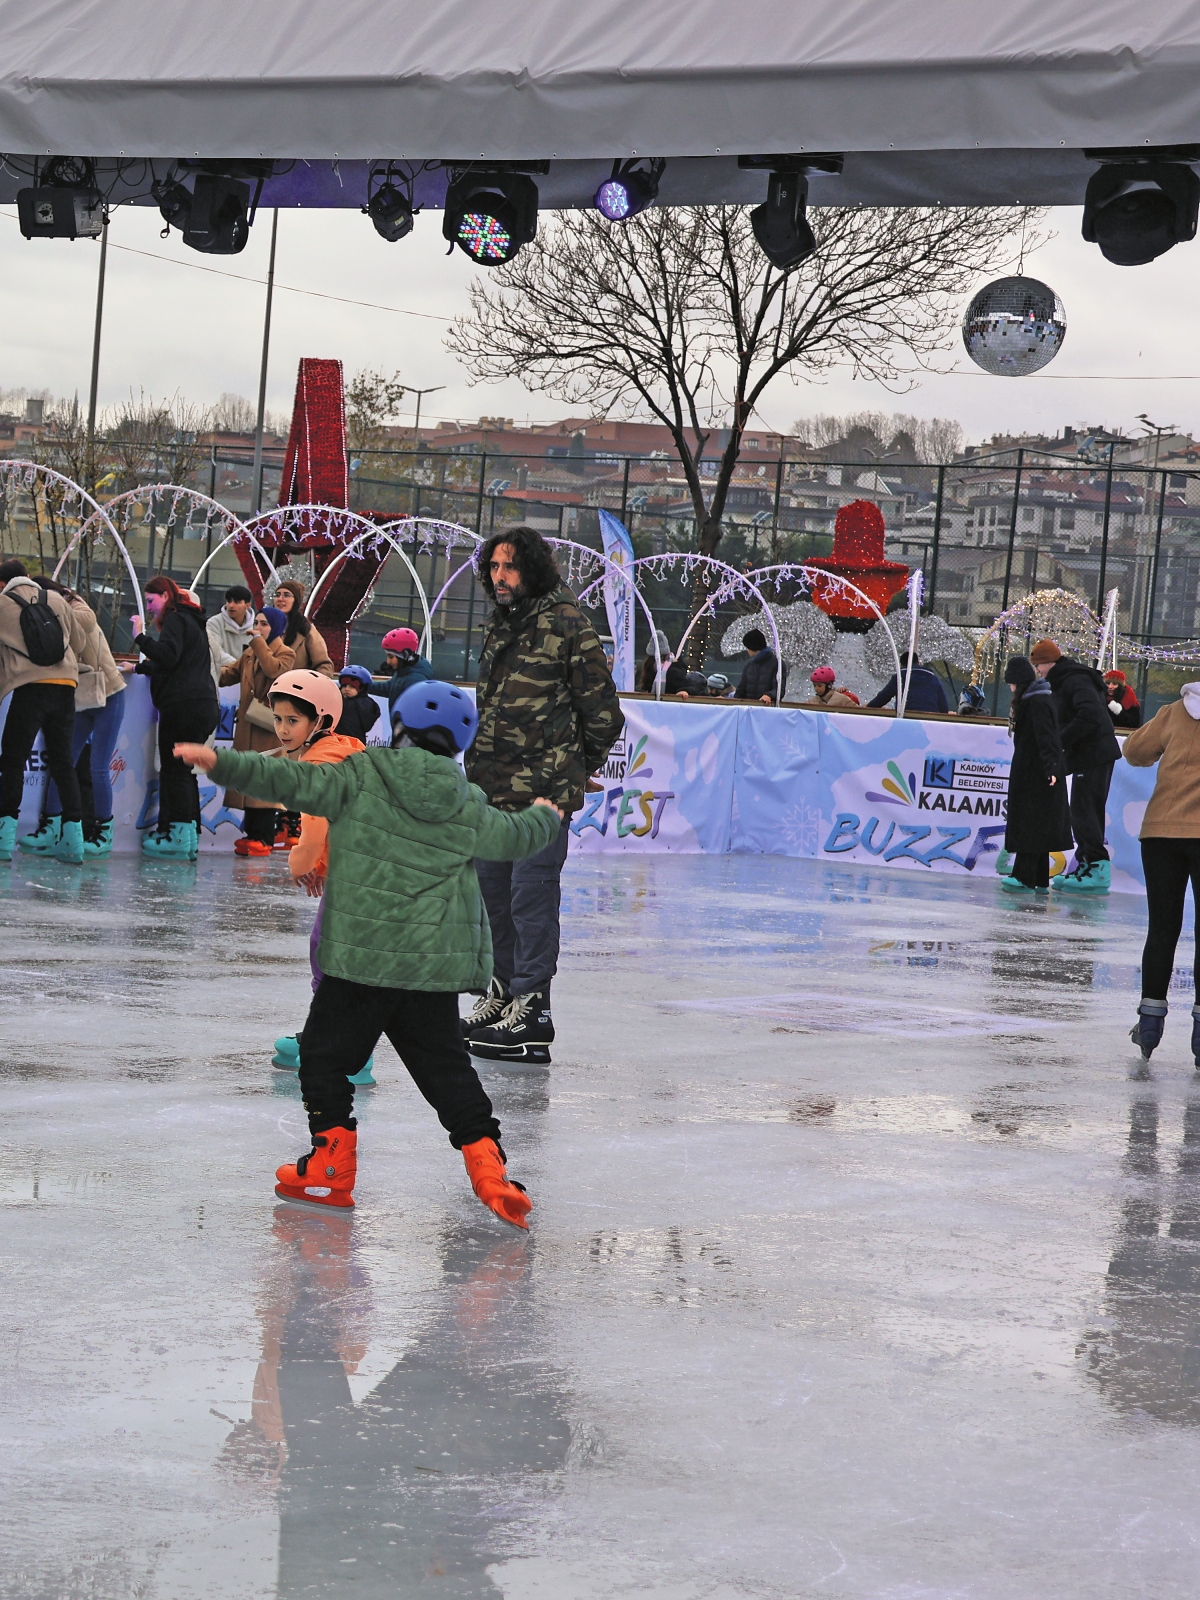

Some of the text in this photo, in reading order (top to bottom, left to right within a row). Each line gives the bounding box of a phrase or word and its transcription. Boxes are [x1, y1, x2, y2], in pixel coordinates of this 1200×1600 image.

[599, 761, 627, 783] AMIŞ
[959, 763, 996, 774] KADIKÖY
[958, 778, 1004, 790] BELEDİYESİ
[569, 786, 675, 840] ZFEST
[823, 812, 1066, 877] BUZZF
